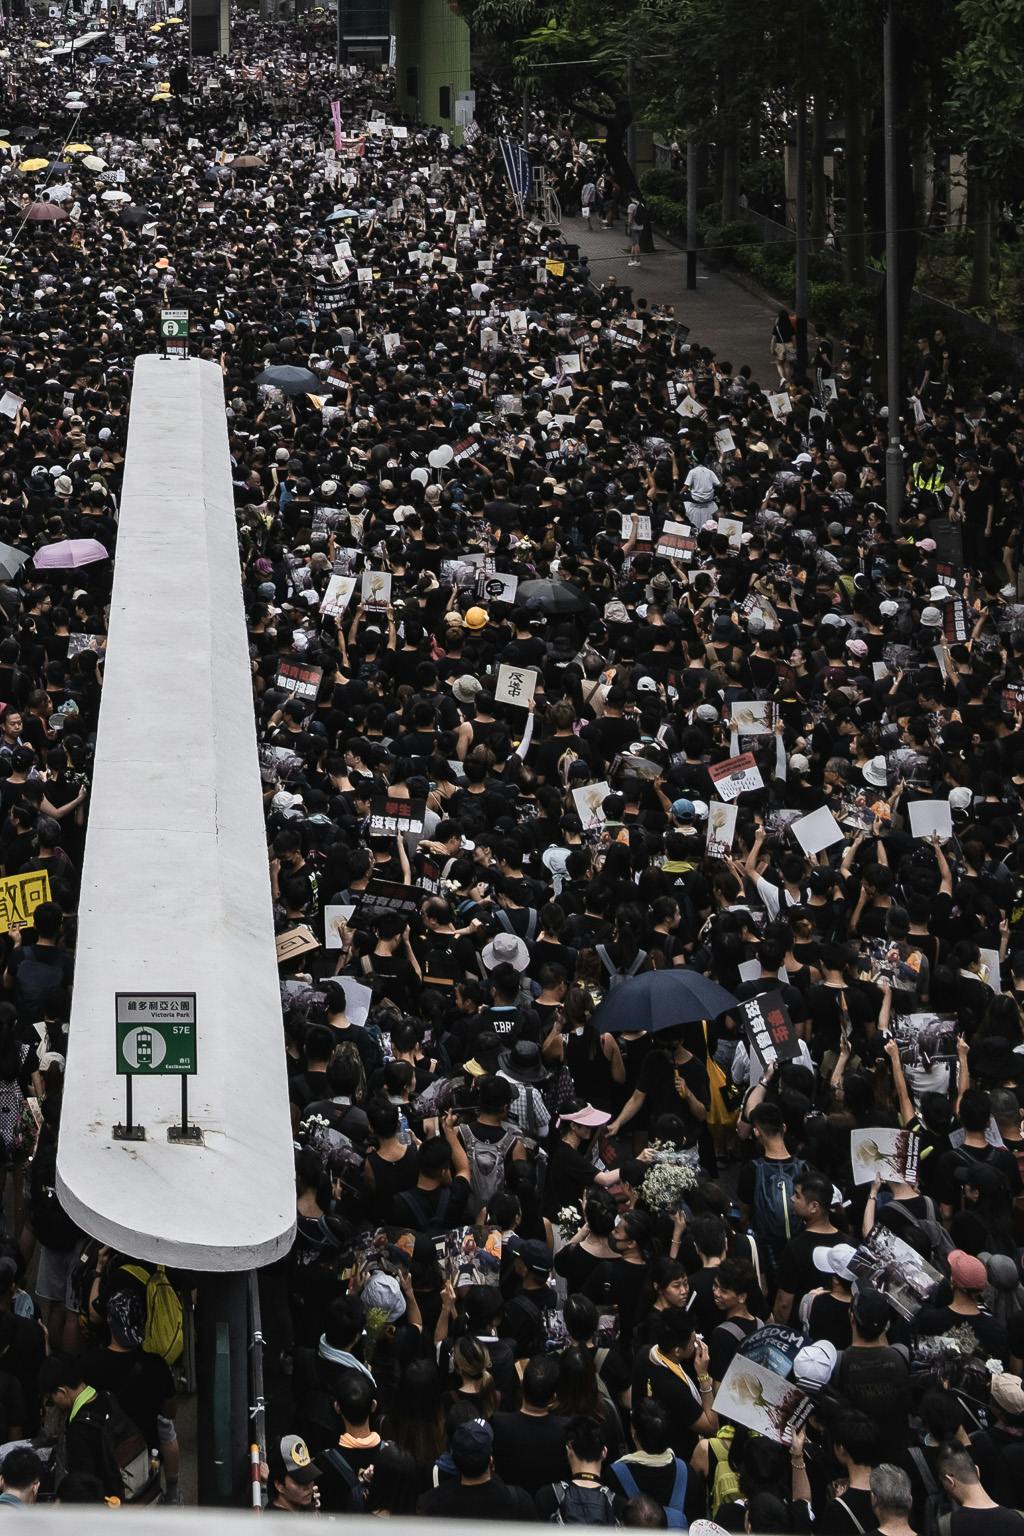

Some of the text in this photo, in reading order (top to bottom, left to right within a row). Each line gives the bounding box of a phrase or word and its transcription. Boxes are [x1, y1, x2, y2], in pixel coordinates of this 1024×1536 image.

[507, 671, 525, 697] 反送中
[127, 1000, 190, 1011] 維多利亞公園
[905, 1169, 917, 1183] NO
